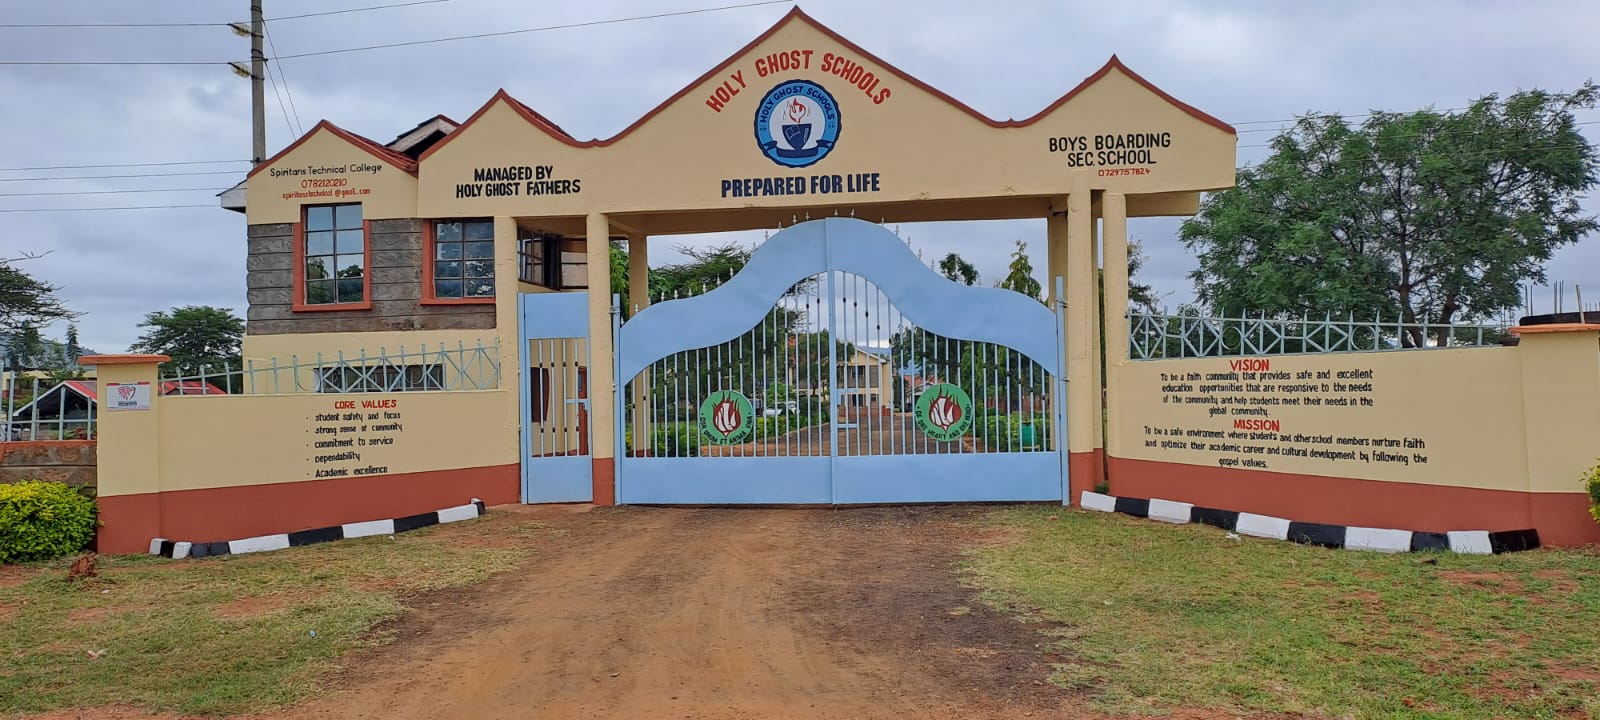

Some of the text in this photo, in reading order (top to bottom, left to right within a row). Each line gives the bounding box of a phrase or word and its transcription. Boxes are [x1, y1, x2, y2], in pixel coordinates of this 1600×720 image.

[706, 50, 891, 112] HOLY GHOST SCHOOLS
[760, 86, 834, 122] HOLY GHOST SCHOOLS
[1049, 133, 1171, 152] BOYS BOARDING
[1098, 150, 1157, 165] SCHOOL
[270, 164, 382, 178] Spiritans Technical College
[474, 166, 553, 182] MANAGED BY
[1098, 168, 1150, 176] 0729757824
[301, 178, 347, 188] 0782120210
[456, 179, 581, 198] HOLY GHOST FATHERS
[722, 173, 880, 197] PREPARED FOR LIFE
[1230, 359, 1269, 371] VISION
[1187, 372, 1201, 380] faith
[1206, 372, 1239, 382] community
[1243, 372, 1256, 380] that
[1260, 371, 1290, 381] provides
[1296, 370, 1312, 379] safe
[1317, 369, 1330, 379] and
[1337, 369, 1373, 379] excellent
[1162, 382, 1372, 394] education opportunities that are responsive to the needs
[335, 400, 397, 409] CORE VALUES
[1173, 395, 1182, 403] the
[1185, 395, 1218, 405] community
[1221, 396, 1232, 404] and
[1234, 396, 1247, 406] help
[1250, 396, 1279, 405] students
[1304, 396, 1321, 405] their
[1325, 397, 1347, 406] needs
[1350, 396, 1357, 405] in
[1360, 397, 1373, 406] the
[315, 411, 400, 422] student safety and focus
[1209, 407, 1227, 417] global
[315, 427, 336, 436] strong
[372, 423, 402, 432] community
[1234, 419, 1279, 432] MISSION
[315, 436, 393, 448] commitment to service
[1144, 426, 1151, 434] To
[1154, 427, 1162, 435] be
[1170, 427, 1183, 436] safe
[1187, 430, 1224, 438] environment
[1228, 431, 1248, 440] where
[1250, 432, 1277, 440] students
[1280, 434, 1291, 442] and
[1336, 437, 1369, 446] members
[1372, 438, 1400, 447] nurture
[1404, 438, 1425, 448] faith
[1161, 441, 1186, 450] optimize
[1191, 442, 1205, 450] their
[1209, 443, 1240, 452] academic
[1243, 446, 1264, 454] career
[1267, 447, 1279, 455] and
[1282, 447, 1307, 456] cultural
[1310, 448, 1355, 461] development
[1360, 451, 1369, 463] by
[1372, 450, 1408, 465] following
[1414, 454, 1427, 463] the
[1219, 457, 1268, 468] gospel values.
[316, 466, 387, 478] Academic excellence
